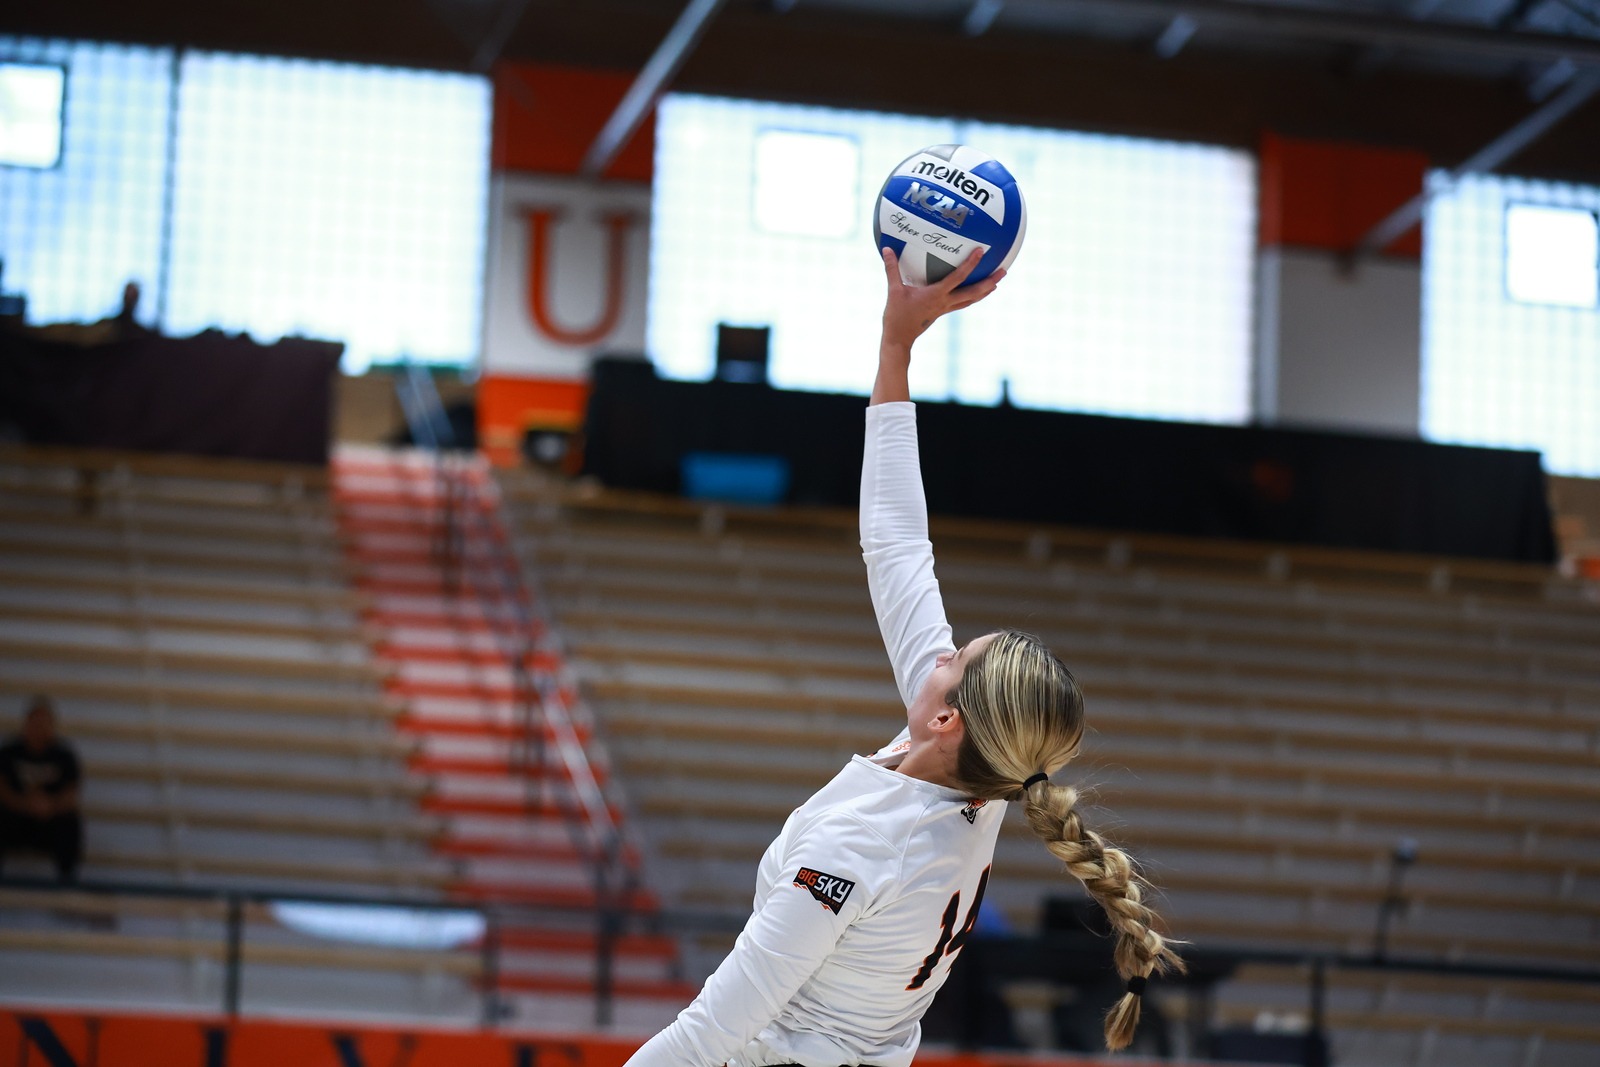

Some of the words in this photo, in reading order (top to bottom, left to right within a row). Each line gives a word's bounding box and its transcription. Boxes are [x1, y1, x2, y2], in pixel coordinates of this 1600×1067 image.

[902, 181, 970, 226] NCAA
[911, 161, 990, 206] molten
[890, 211, 919, 236] Super
[922, 232, 963, 254] Touch
[515, 203, 649, 346] U
